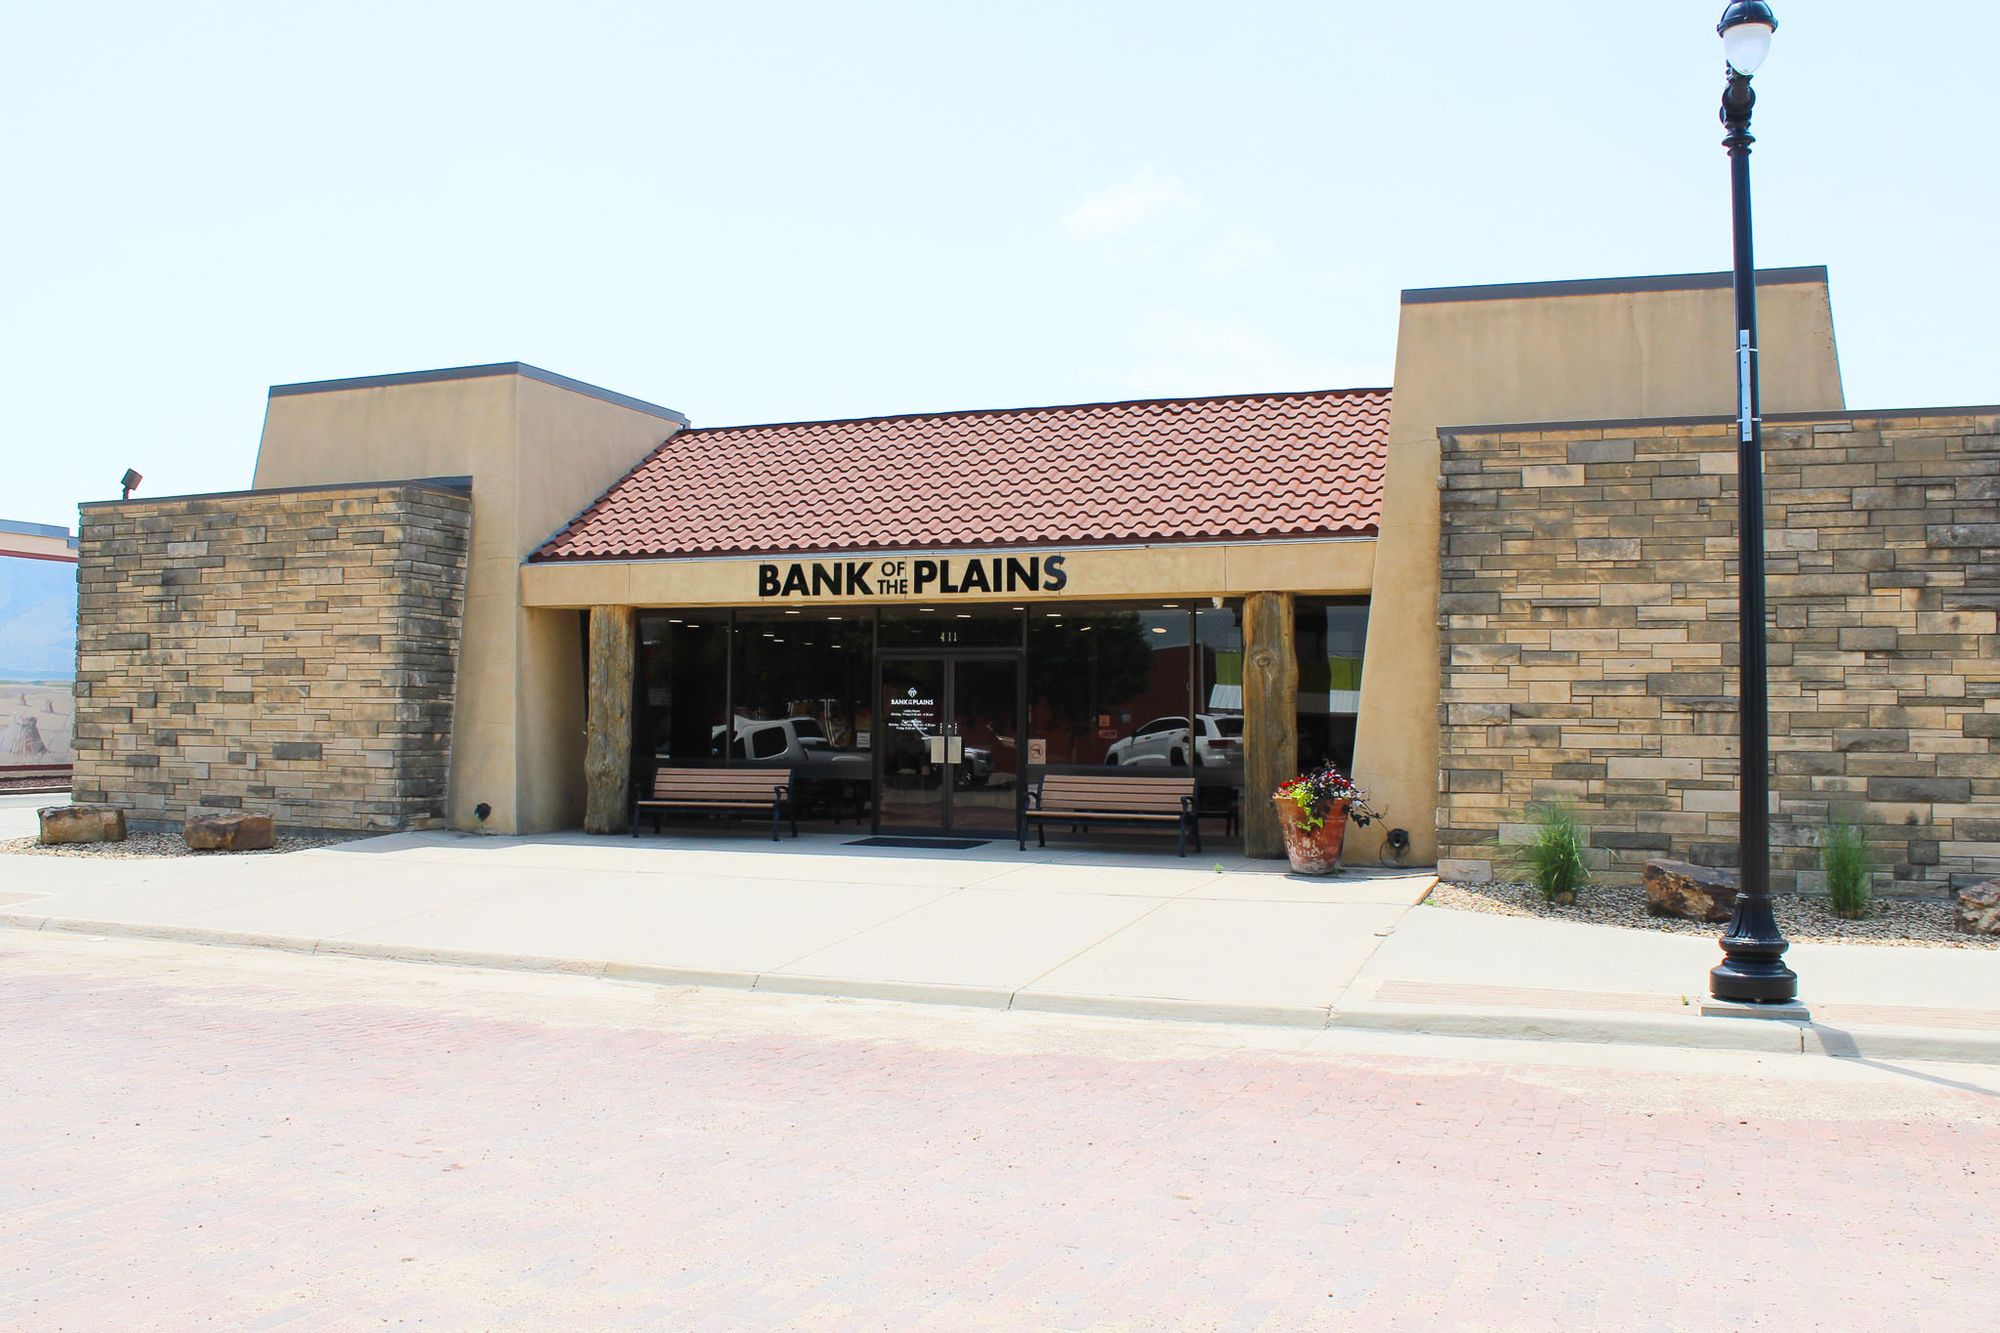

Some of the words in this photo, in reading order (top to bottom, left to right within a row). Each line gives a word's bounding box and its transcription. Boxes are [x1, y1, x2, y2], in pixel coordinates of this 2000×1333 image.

[881, 561, 906, 577] OF
[914, 555, 1067, 594] PLAINS
[758, 561, 874, 597] BANK
[877, 579, 908, 595] THE
[940, 631, 957, 642] 411
